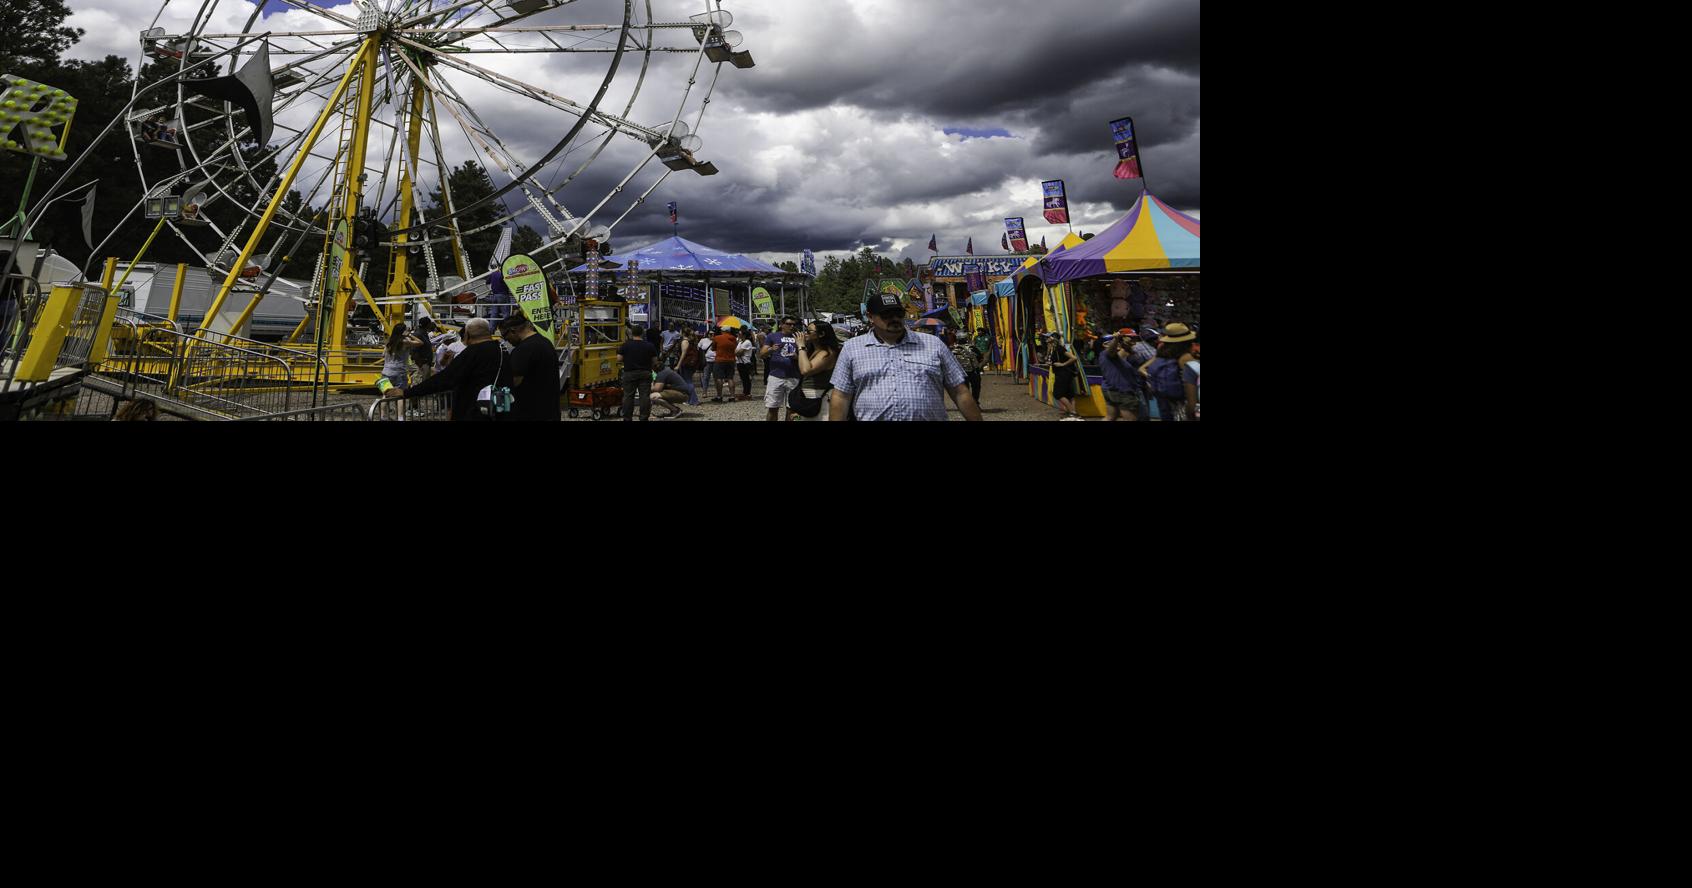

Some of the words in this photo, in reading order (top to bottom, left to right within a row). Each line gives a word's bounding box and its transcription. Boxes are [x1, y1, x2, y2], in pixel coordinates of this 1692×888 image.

[944, 261, 1013, 273] WKY
[520, 281, 545, 293] FAST
[519, 291, 542, 302] PASS
[552, 308, 569, 318] XIT
